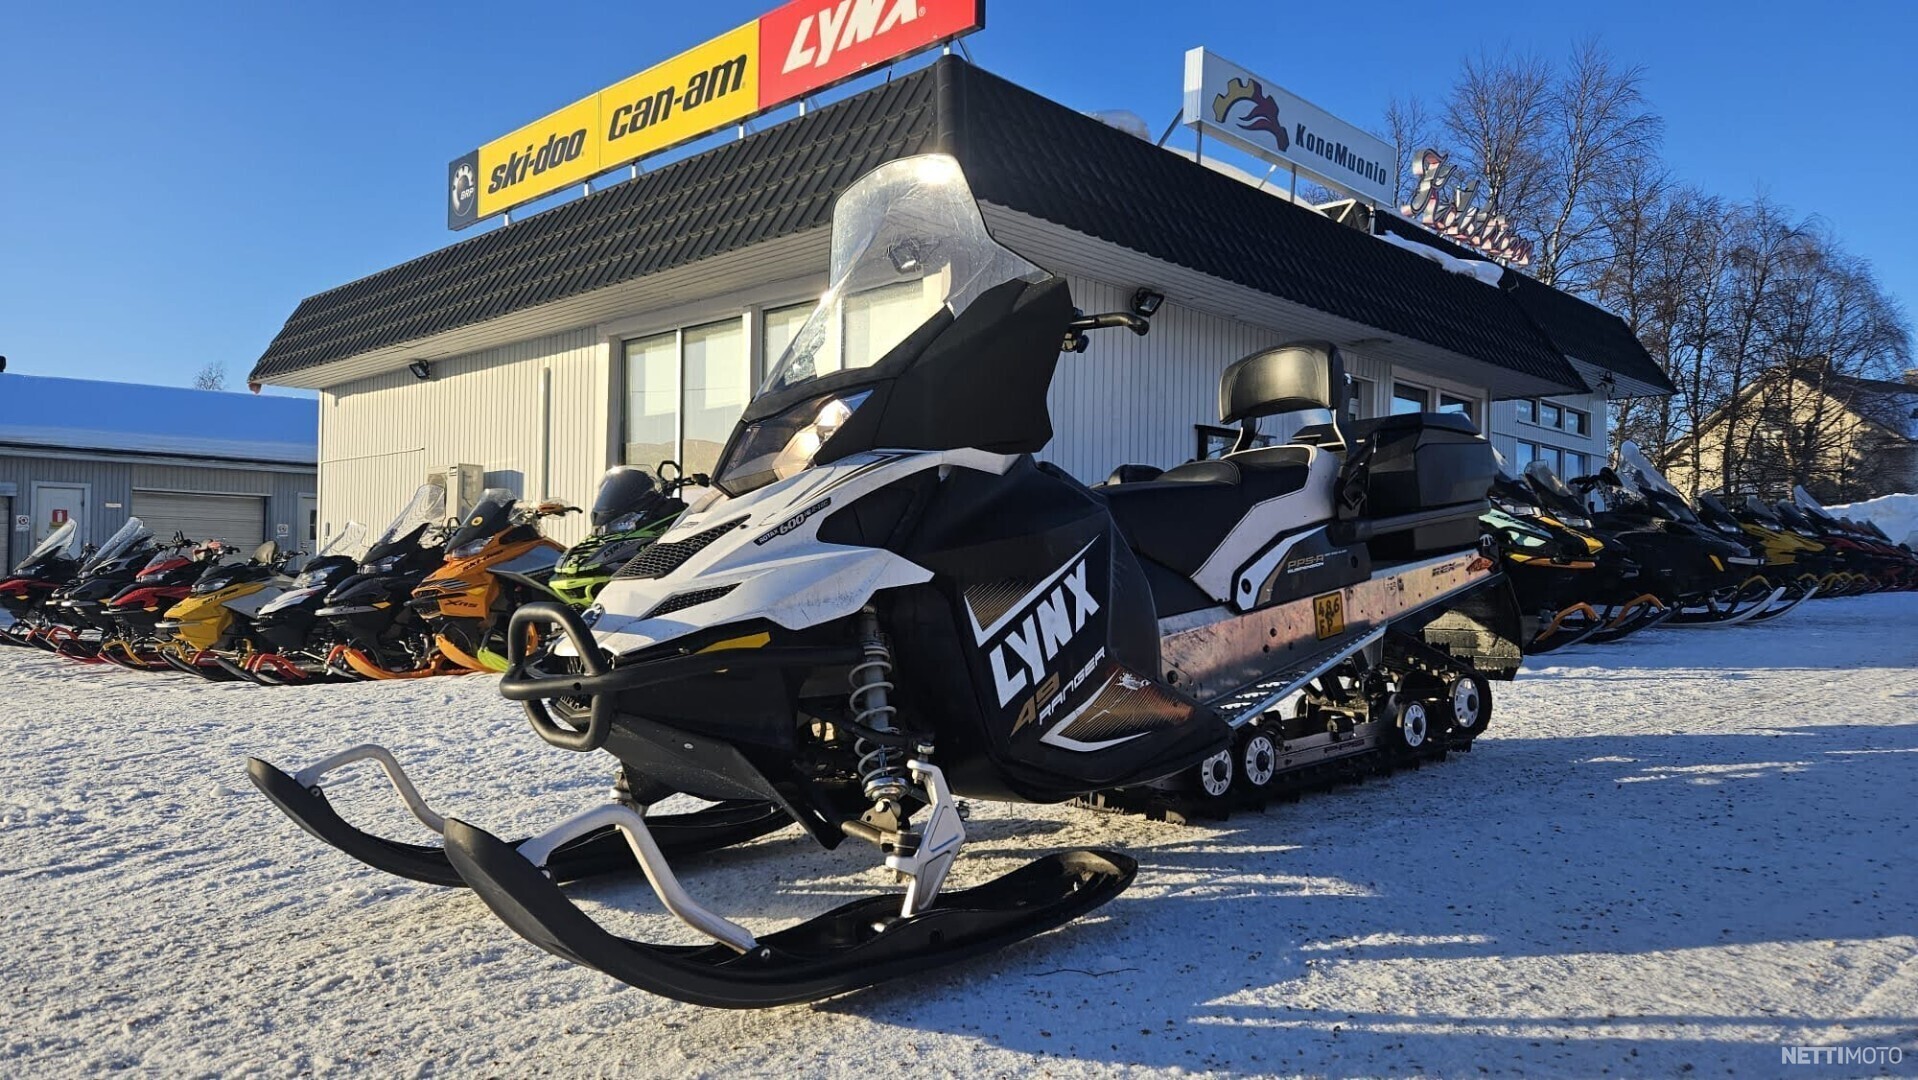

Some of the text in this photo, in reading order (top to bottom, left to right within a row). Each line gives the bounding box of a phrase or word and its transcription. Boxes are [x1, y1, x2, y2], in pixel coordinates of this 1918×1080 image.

[608, 54, 747, 142] can-am
[487, 128, 587, 194] ski-doo
[1295, 123, 1387, 186] KoneMuonio
[460, 186, 475, 200] BRP
[759, 528, 779, 543] ROTAX
[780, 514, 805, 534] 600
[989, 558, 1100, 709] LYNX
[1009, 671, 1061, 738] 49
[1039, 645, 1106, 726] RANGER
